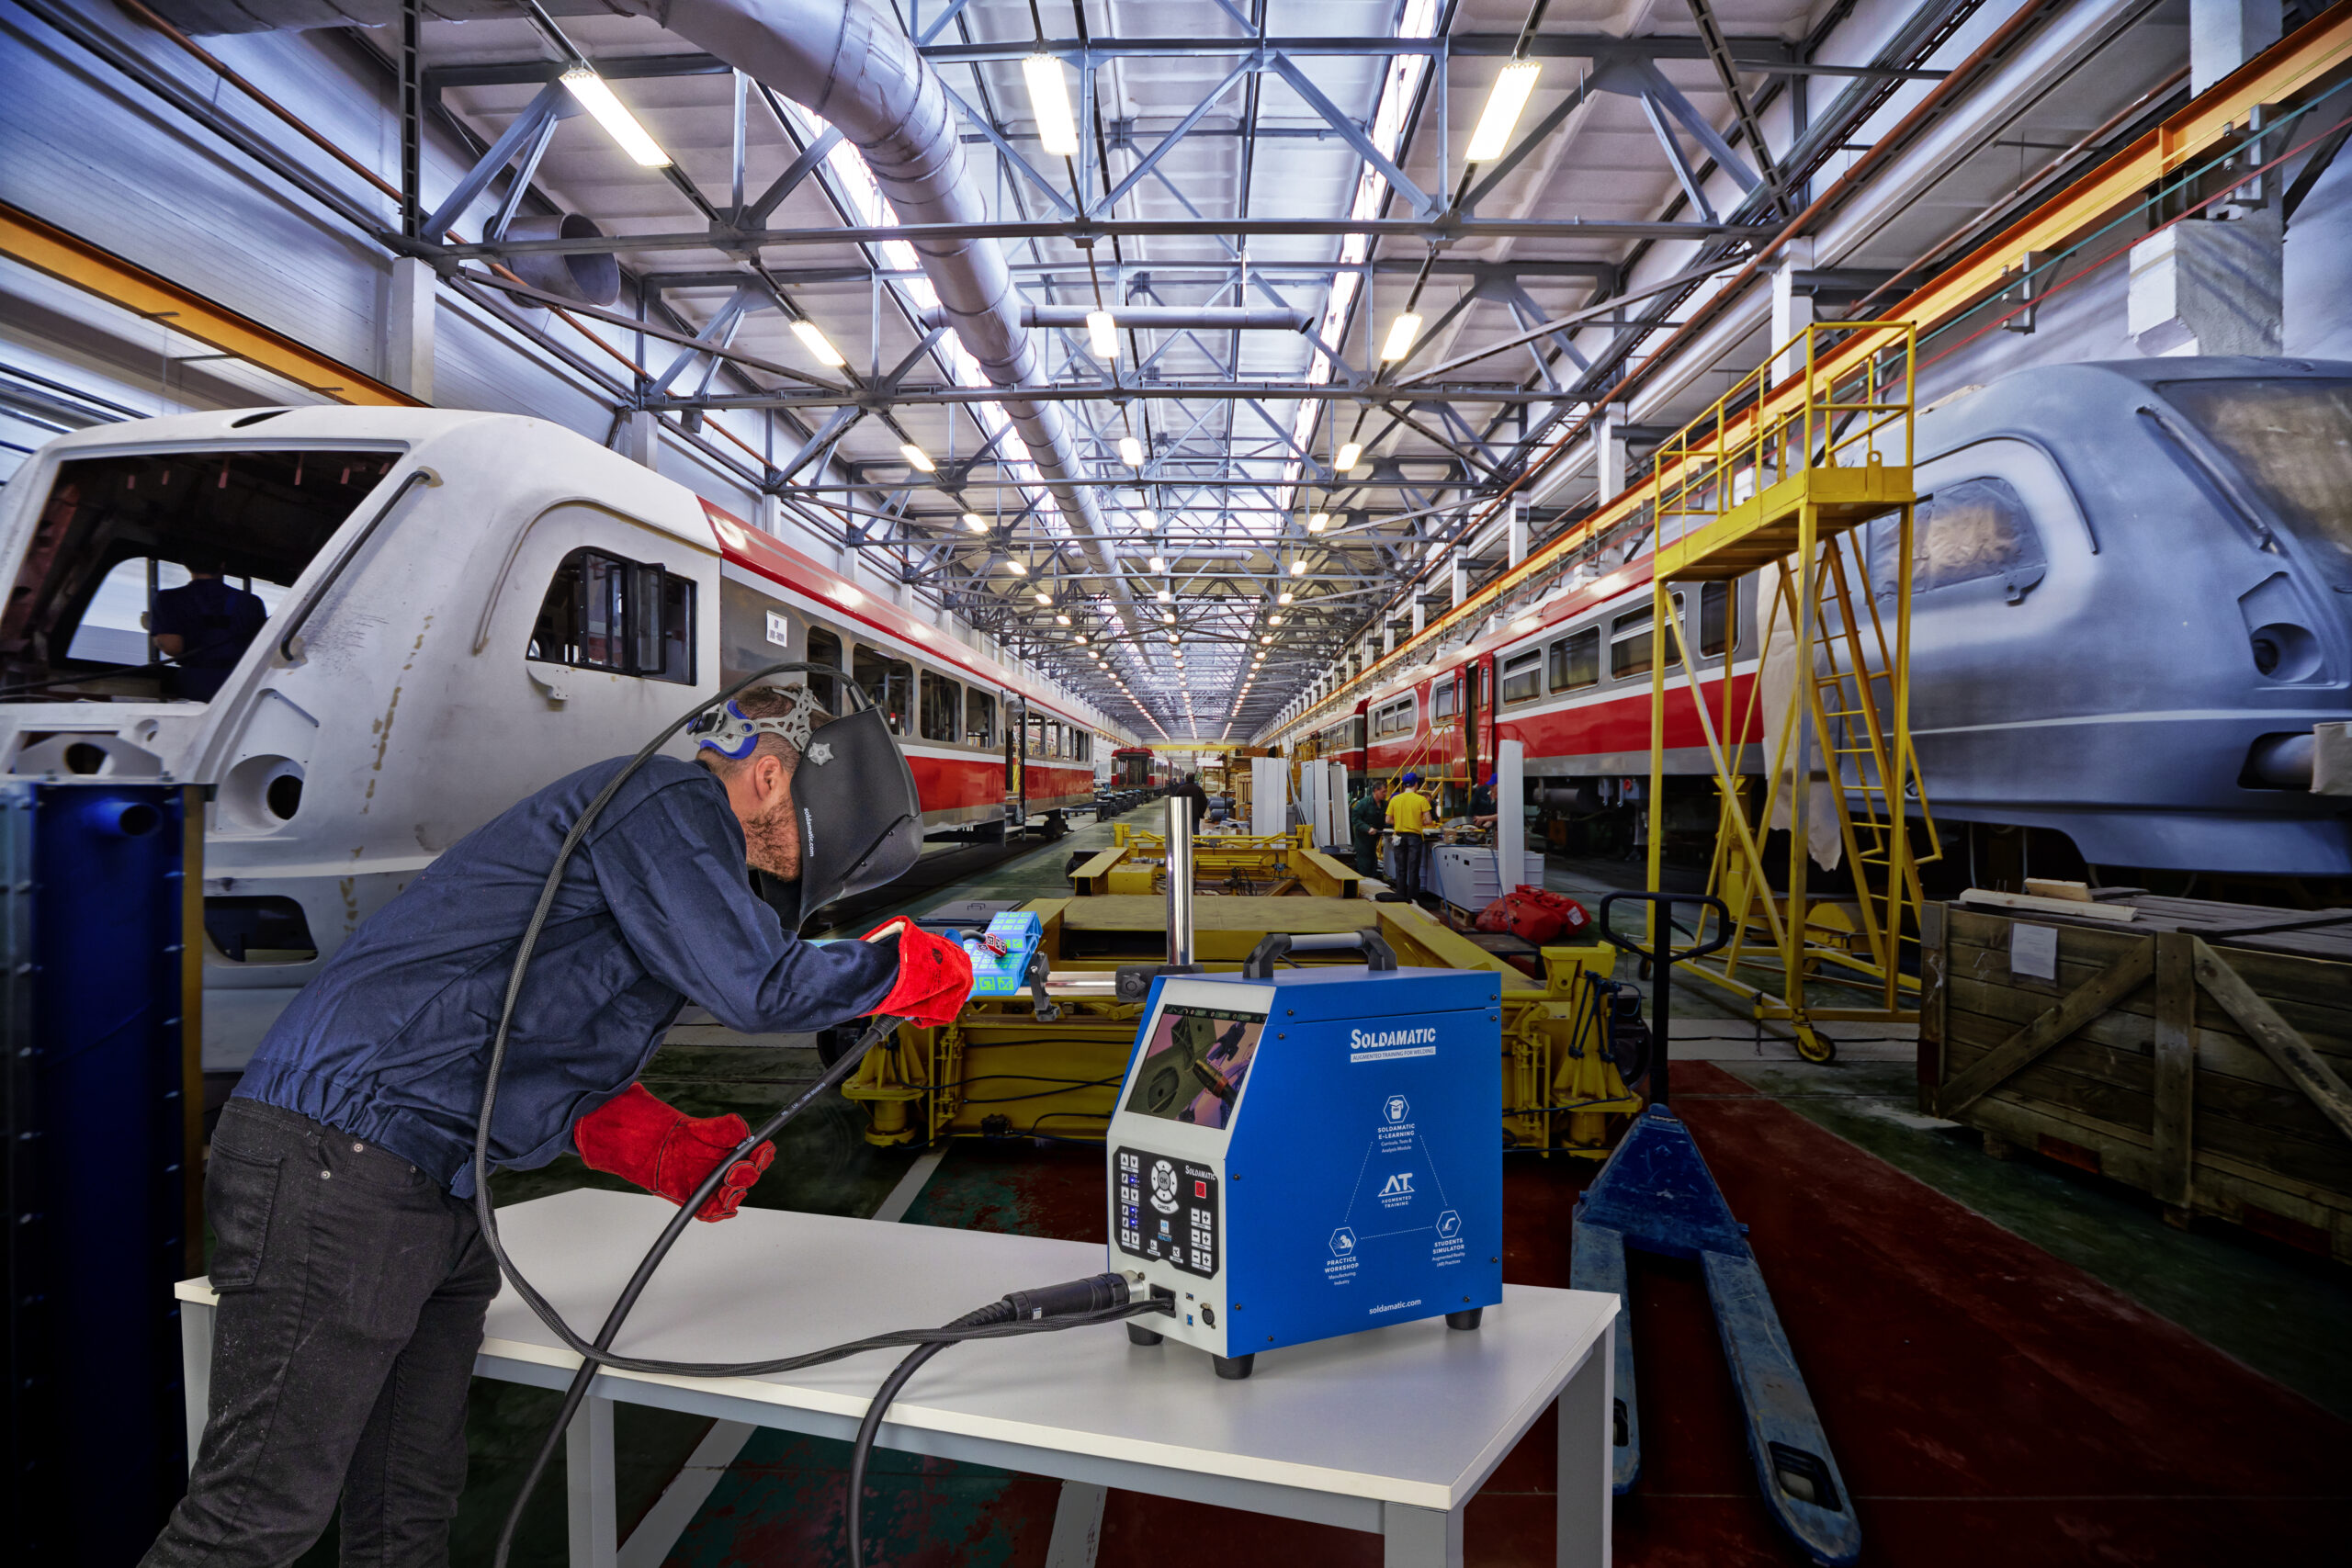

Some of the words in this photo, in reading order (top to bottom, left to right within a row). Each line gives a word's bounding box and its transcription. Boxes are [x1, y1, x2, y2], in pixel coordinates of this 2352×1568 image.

[803, 807, 815, 857] soldamatic.com
[1351, 1027, 1436, 1049] SOLDAMATIC
[1352, 1053, 1382, 1061] AUGMENTED
[1377, 1123, 1416, 1134] SOLDAMATIC
[1378, 1131, 1415, 1140] E-LEARNING
[1159, 1177, 1168, 1185] OK
[1381, 1195, 1412, 1204] AUGMENTED
[1158, 1203, 1171, 1212] CANCEL
[1385, 1201, 1409, 1209] TRAINING
[1434, 1237, 1464, 1247] STUDENTS
[1432, 1244, 1464, 1255] SIMULATOR
[1327, 1256, 1357, 1266] PRACTICE
[1324, 1262, 1360, 1274] WORKSHOP
[1368, 1299, 1422, 1314] soldamatic.com
